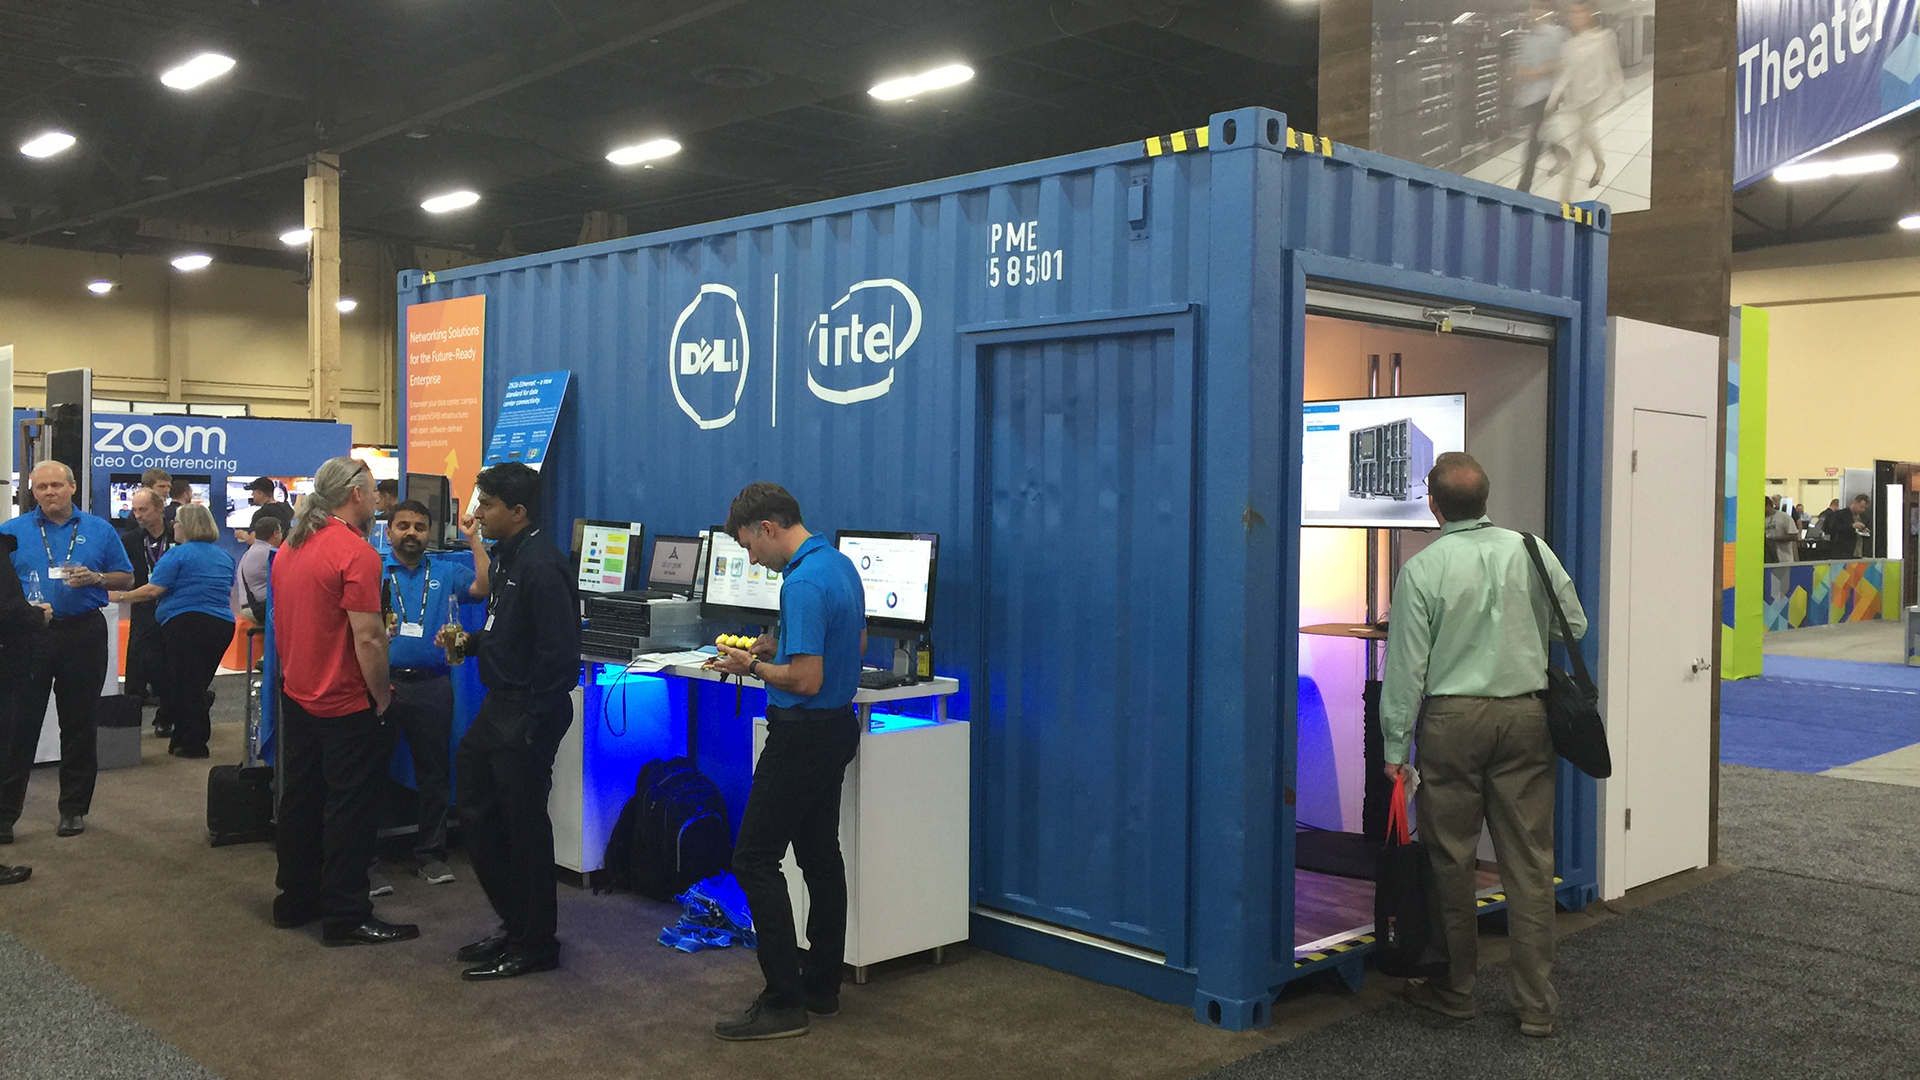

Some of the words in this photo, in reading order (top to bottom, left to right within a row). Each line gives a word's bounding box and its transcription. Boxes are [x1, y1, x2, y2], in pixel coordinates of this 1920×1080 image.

[1738, 0, 1891, 115] Theater
[991, 220, 1038, 254] PME
[410, 329, 447, 343] Networking
[448, 325, 480, 339] Solutions
[410, 353, 419, 365] for
[420, 352, 431, 364] the
[431, 347, 477, 362] Future-Ready
[680, 337, 739, 376] DELL
[410, 374, 441, 388] Enterprise
[94, 422, 227, 455] zoom
[91, 454, 126, 468] ideo
[130, 454, 237, 473] Conferencing
